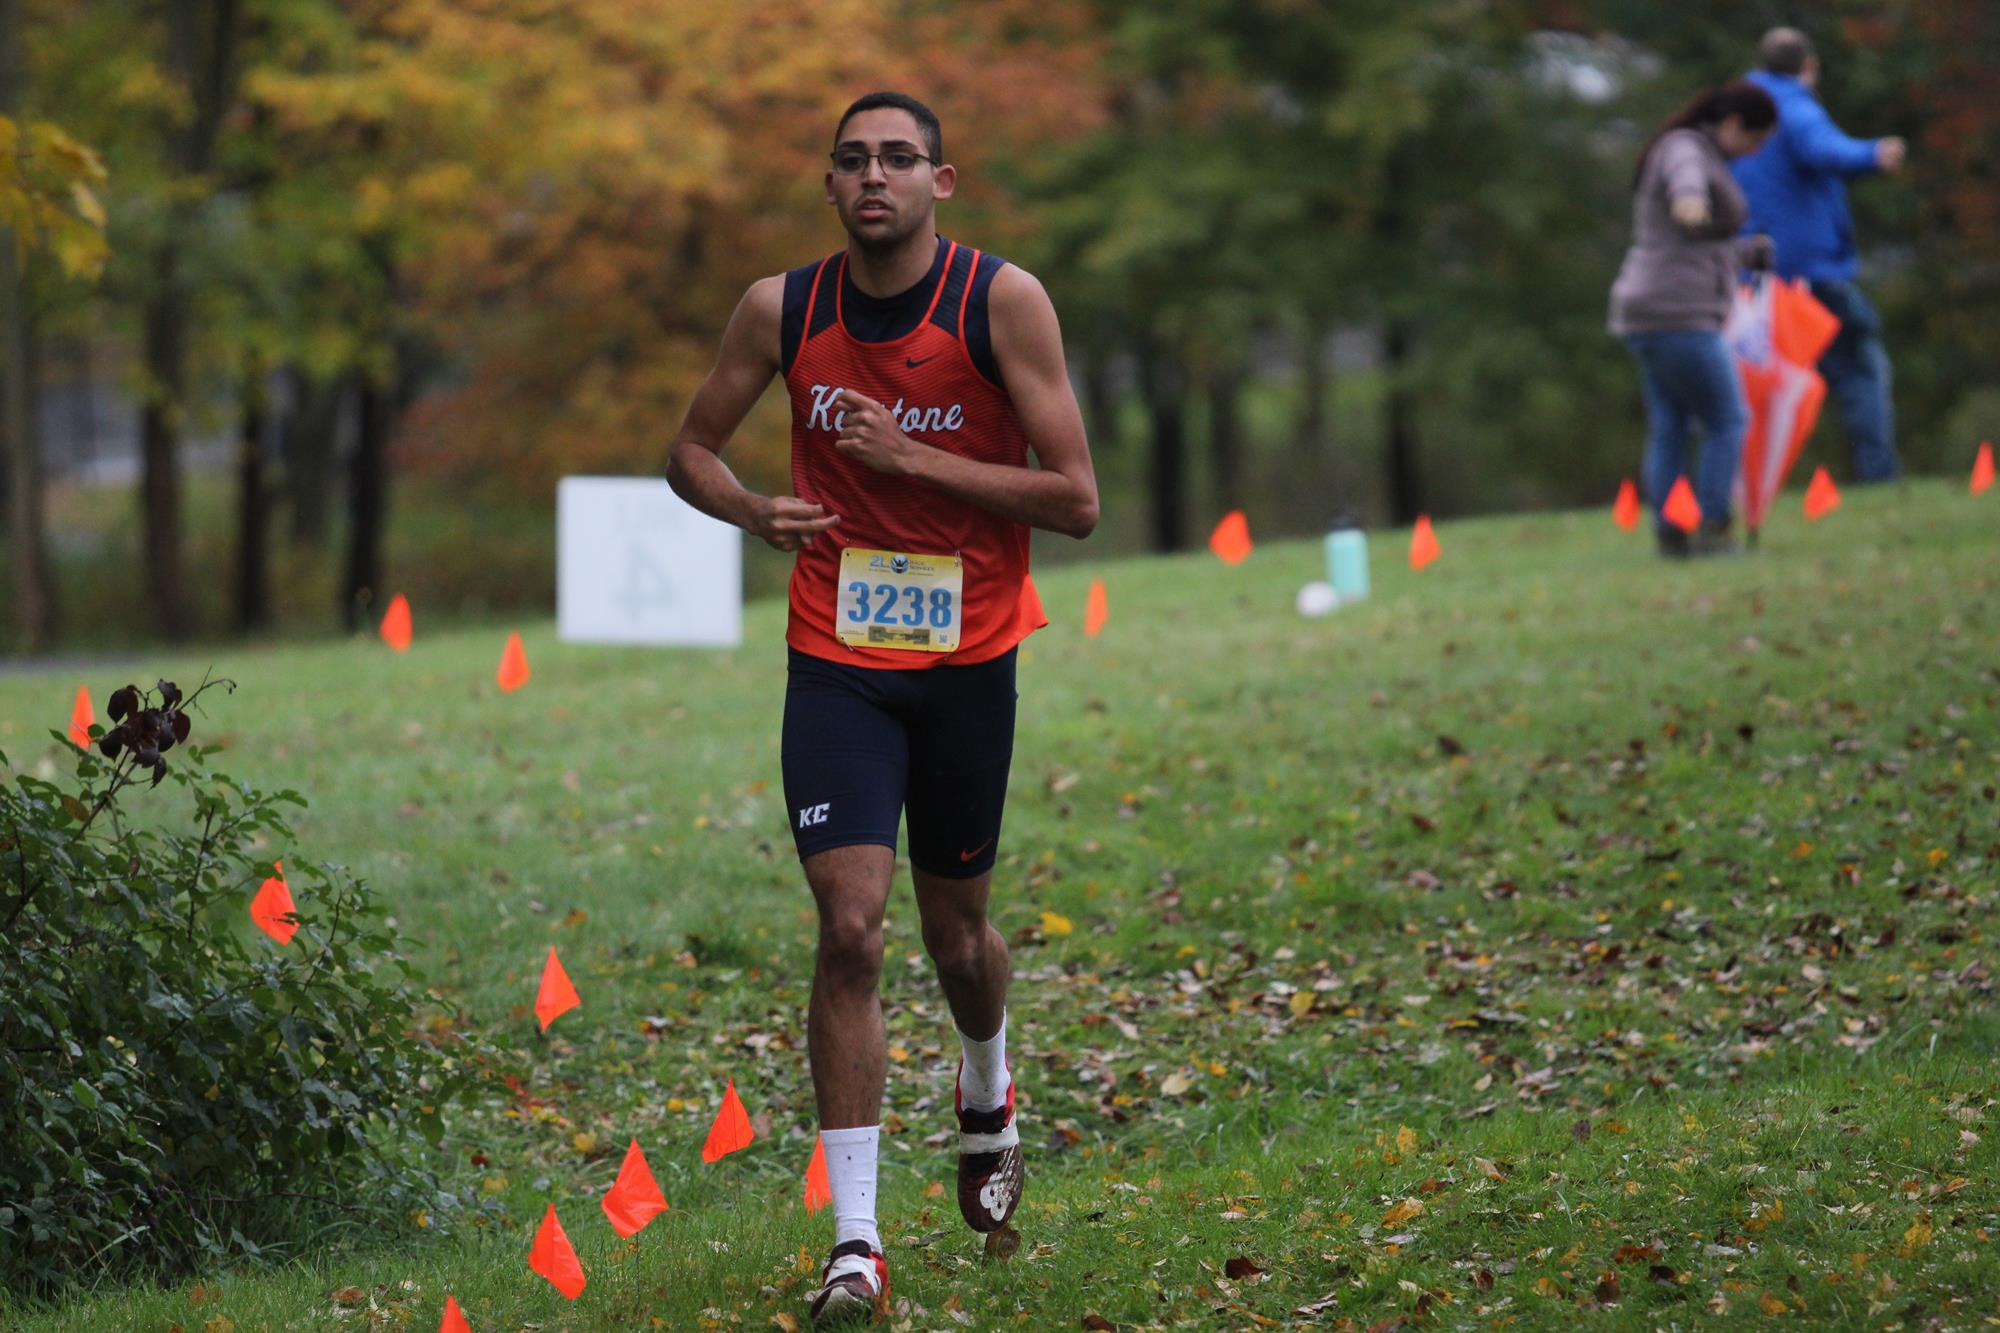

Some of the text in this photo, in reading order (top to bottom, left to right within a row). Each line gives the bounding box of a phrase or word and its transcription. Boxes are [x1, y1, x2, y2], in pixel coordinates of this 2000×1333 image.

[806, 384, 964, 432] Ktone
[847, 581, 952, 629] 3238
[799, 803, 830, 829] KC
